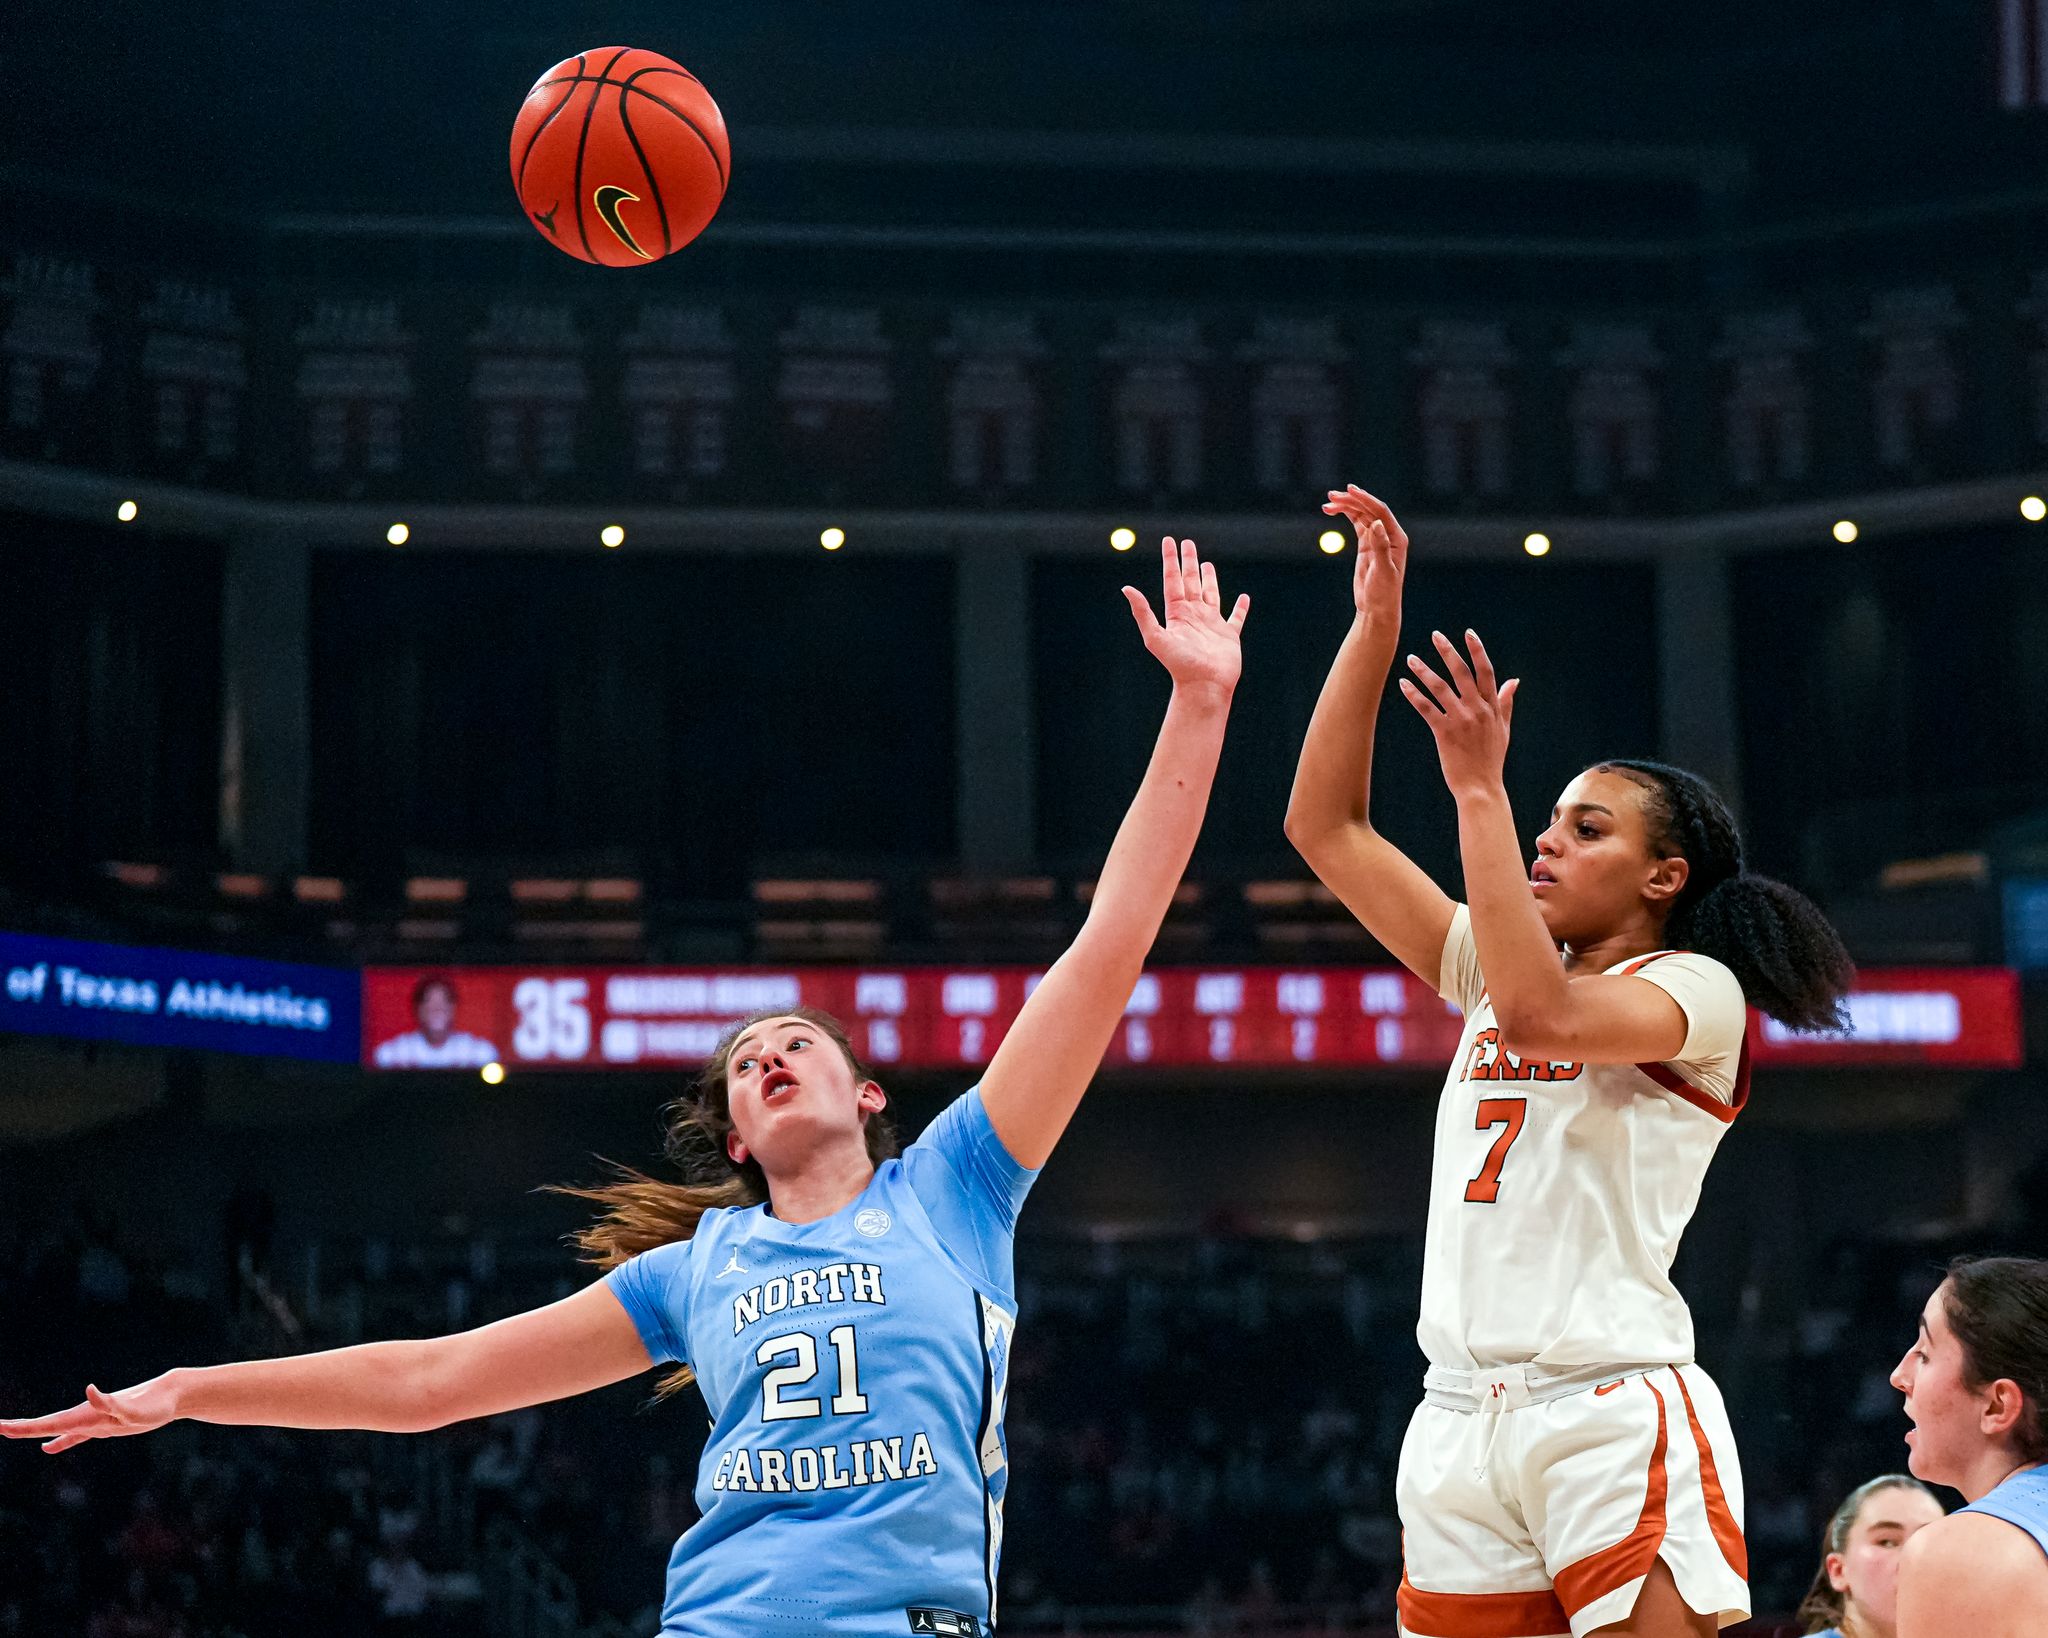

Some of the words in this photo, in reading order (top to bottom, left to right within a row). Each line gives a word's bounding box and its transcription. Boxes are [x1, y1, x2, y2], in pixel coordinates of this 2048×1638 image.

[6, 962, 49, 1002] of
[55, 965, 160, 1014] Texas
[166, 978, 331, 1031] Athletics
[514, 978, 590, 1060] 35
[1464, 1098, 1526, 1203] 7
[733, 1263, 886, 1336] NORTH
[756, 1324, 868, 1423] 21
[712, 1432, 938, 1492] CAROLINA
[960, 1621, 972, 1633] 46
